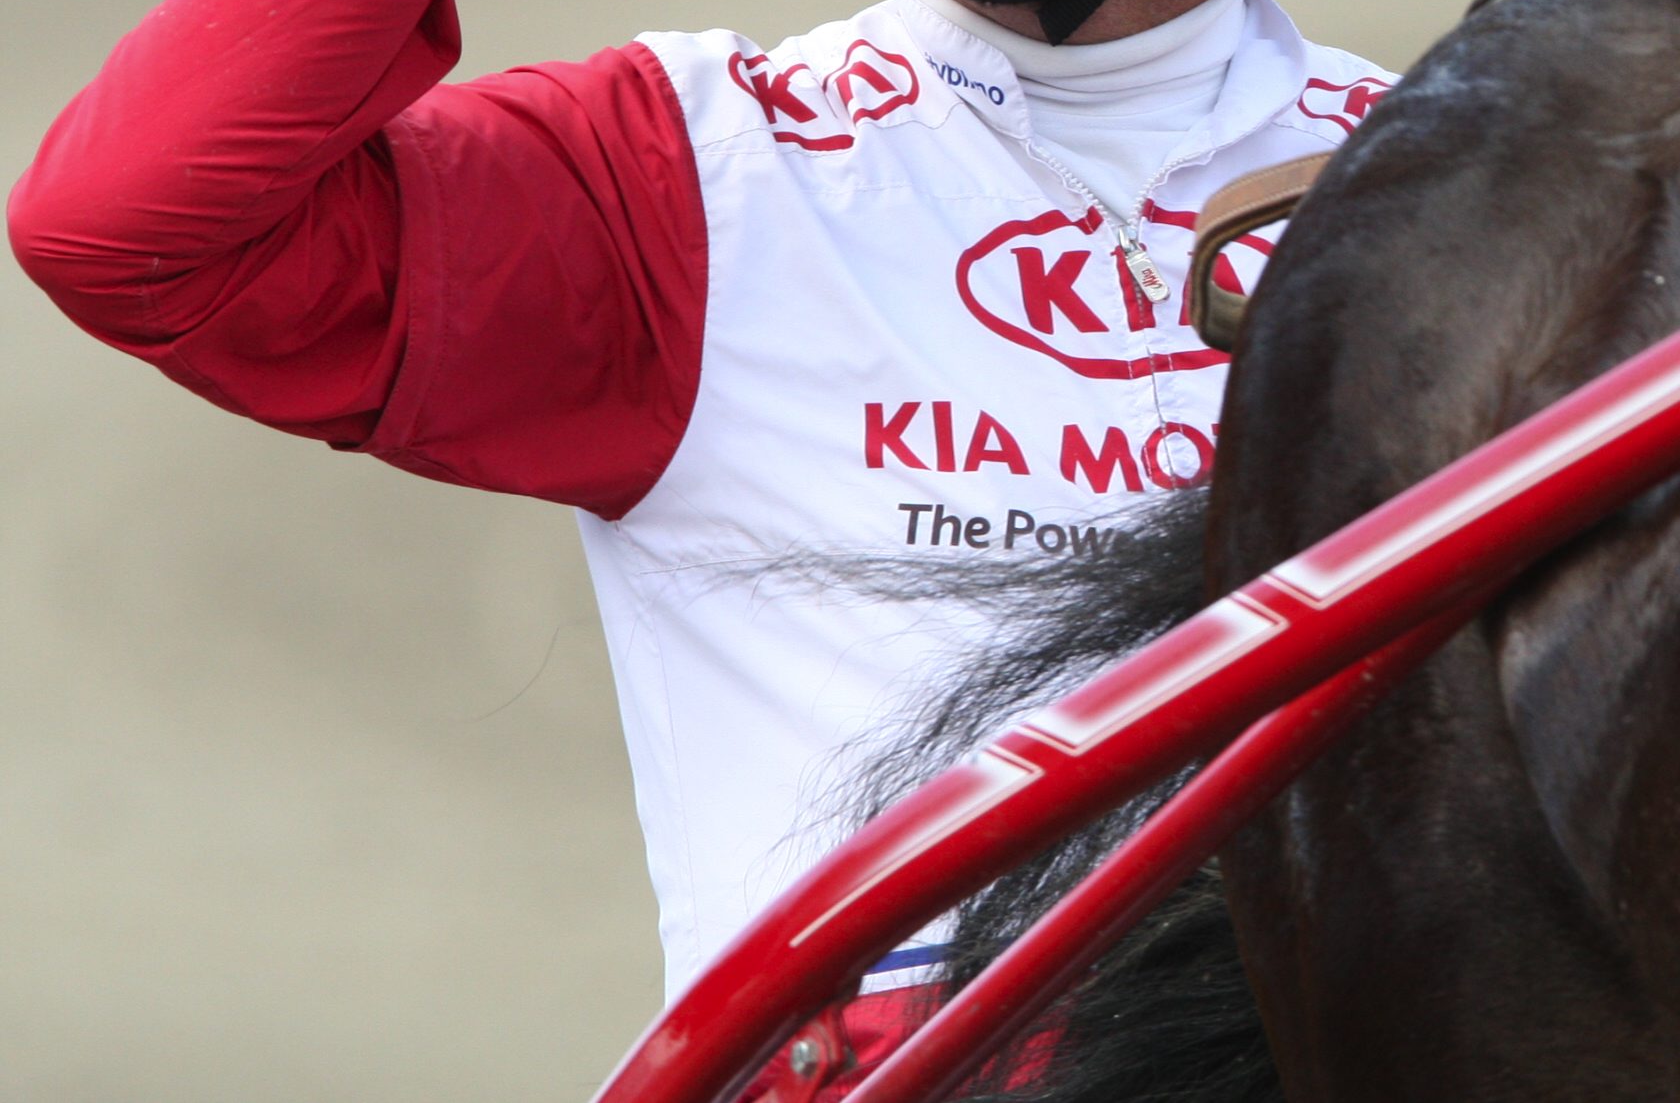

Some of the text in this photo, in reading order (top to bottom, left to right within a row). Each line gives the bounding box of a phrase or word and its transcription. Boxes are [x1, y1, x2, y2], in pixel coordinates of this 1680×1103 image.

[751, 60, 899, 125] KA
[865, 401, 1221, 494] KIA MO
[898, 502, 1132, 558] The Pow
